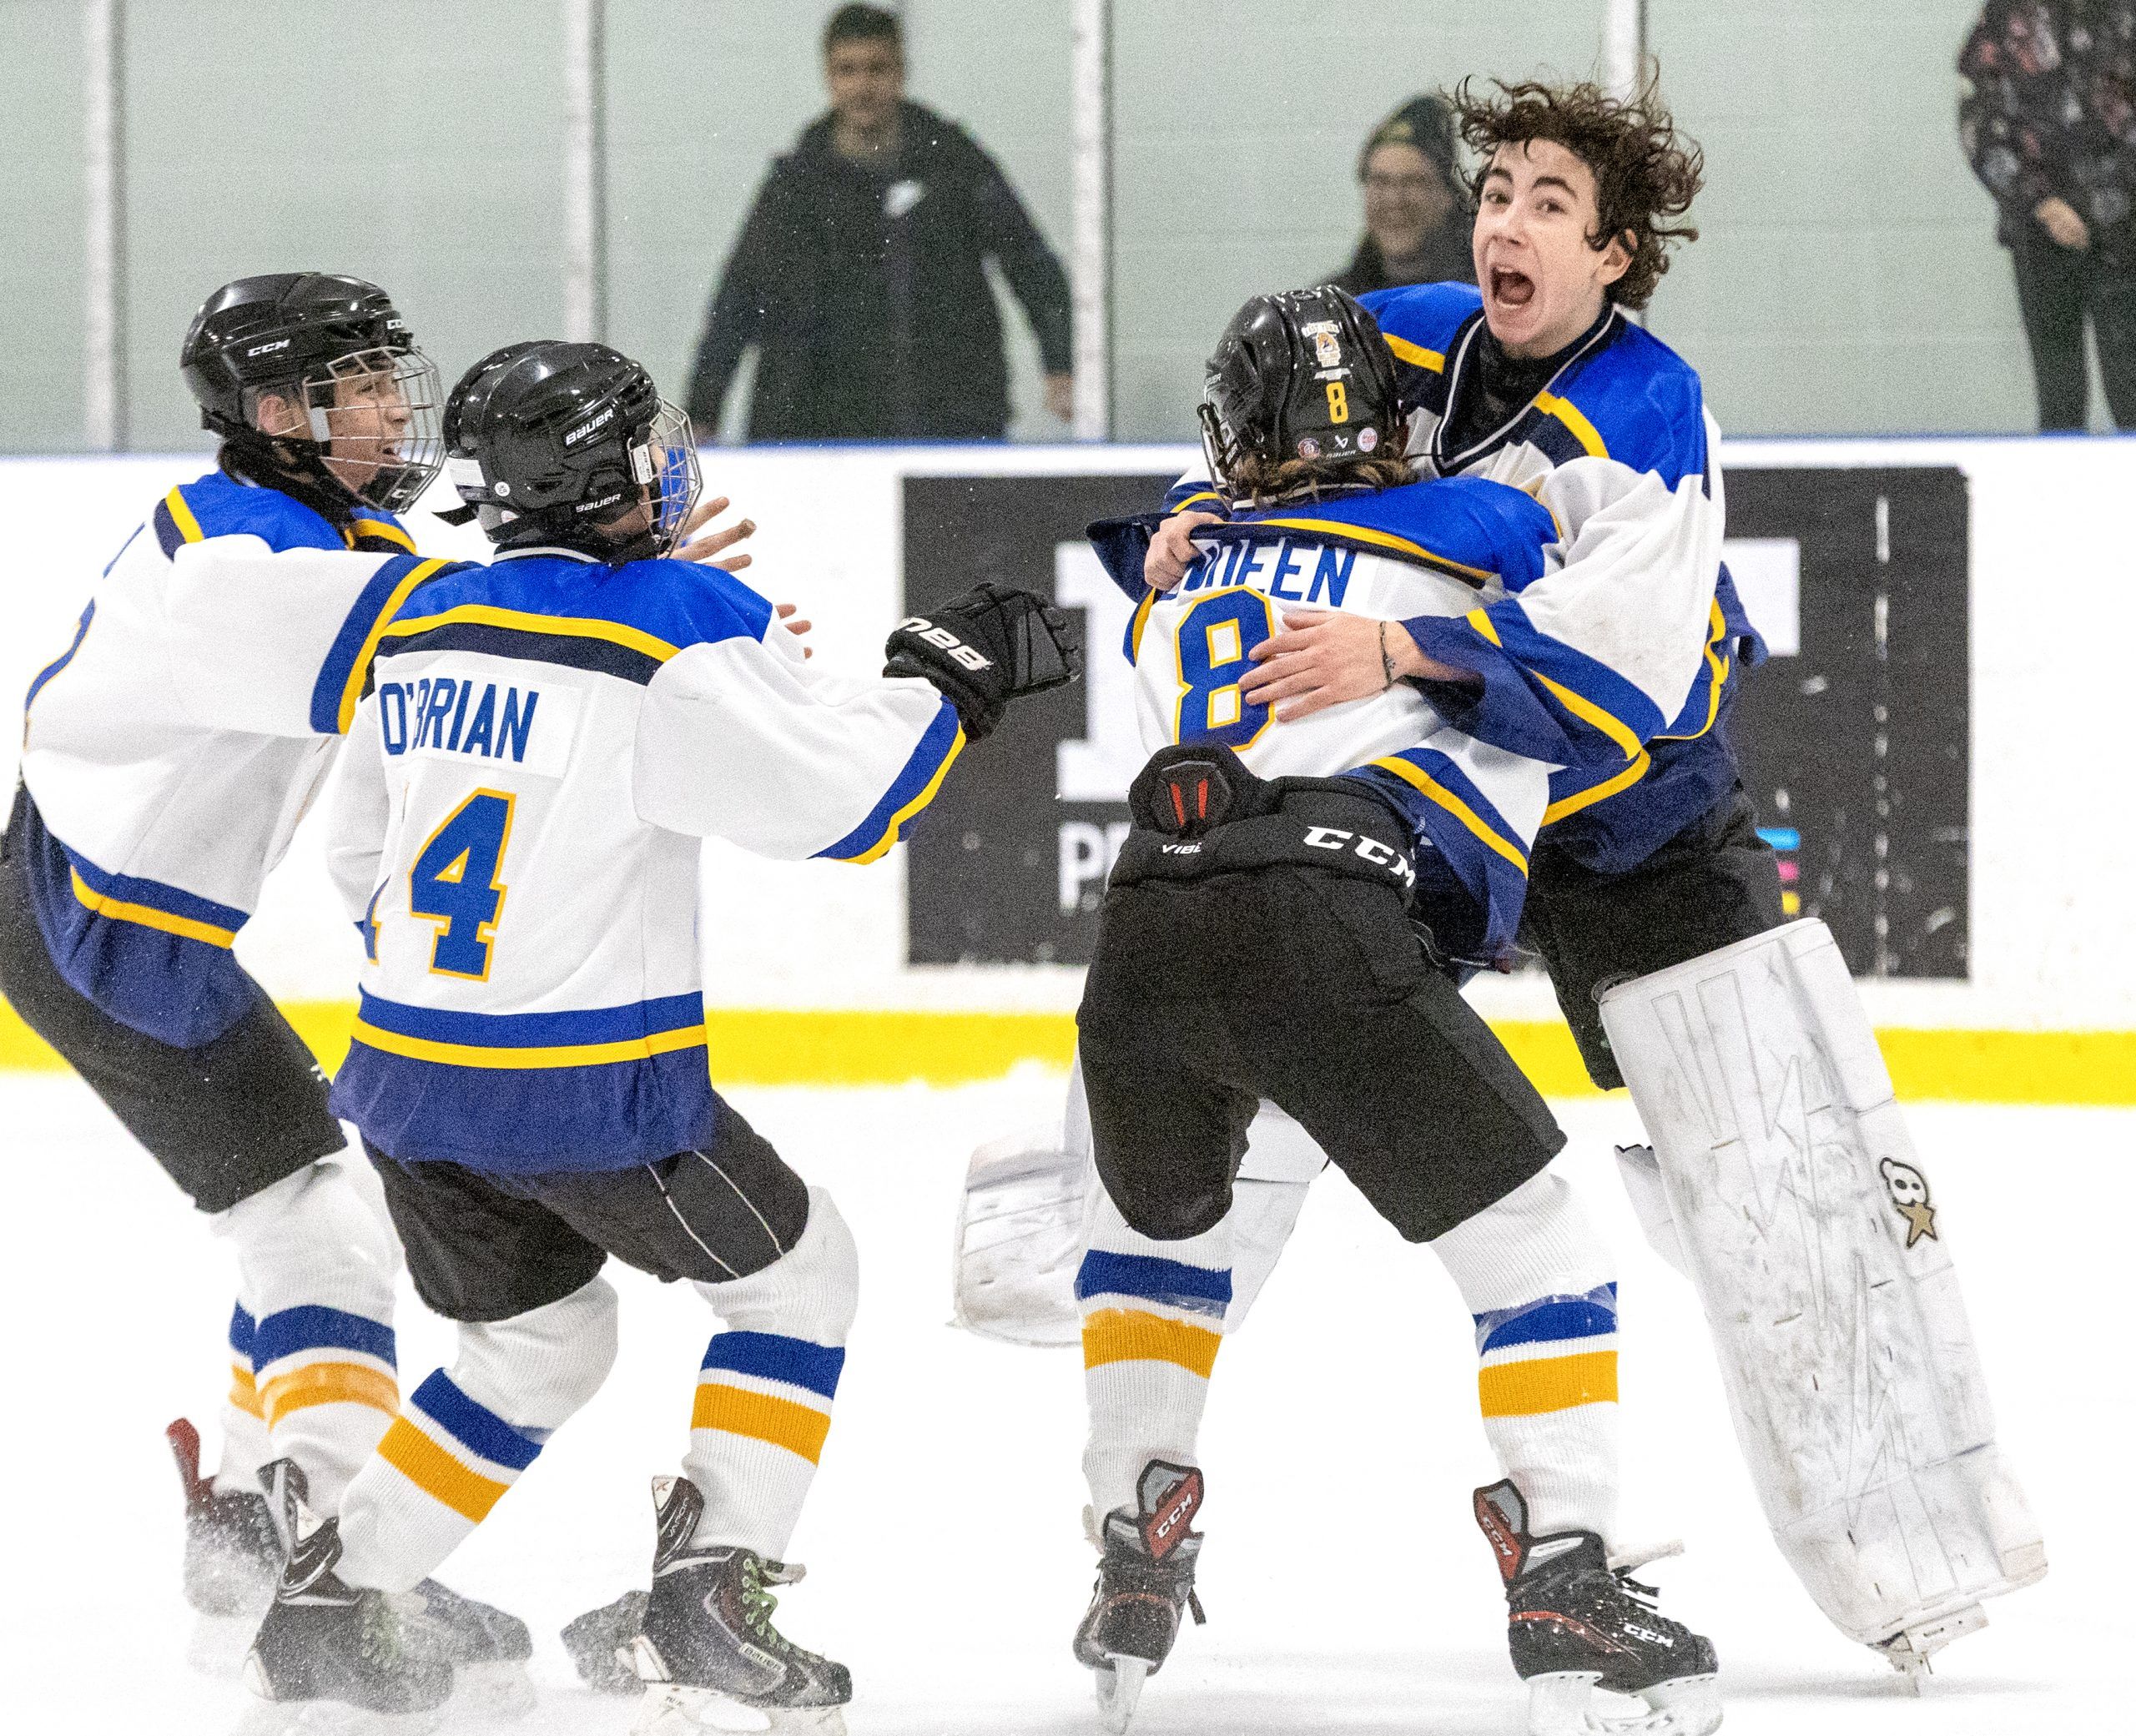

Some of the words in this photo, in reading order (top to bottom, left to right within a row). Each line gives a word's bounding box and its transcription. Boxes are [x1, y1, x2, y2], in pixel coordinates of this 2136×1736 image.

[248, 339, 290, 357] CCM
[1326, 381, 1349, 424] 8
[565, 408, 614, 446] BAUER
[1174, 584, 1276, 752] 8
[379, 677, 540, 763] O'BRIAN
[1302, 826, 1416, 888] CCM
[367, 781, 517, 983] 4
[1156, 1492, 1192, 1537] CCM
[1483, 1516, 1513, 1556] CCM
[1623, 1622, 1675, 1648] CCM
